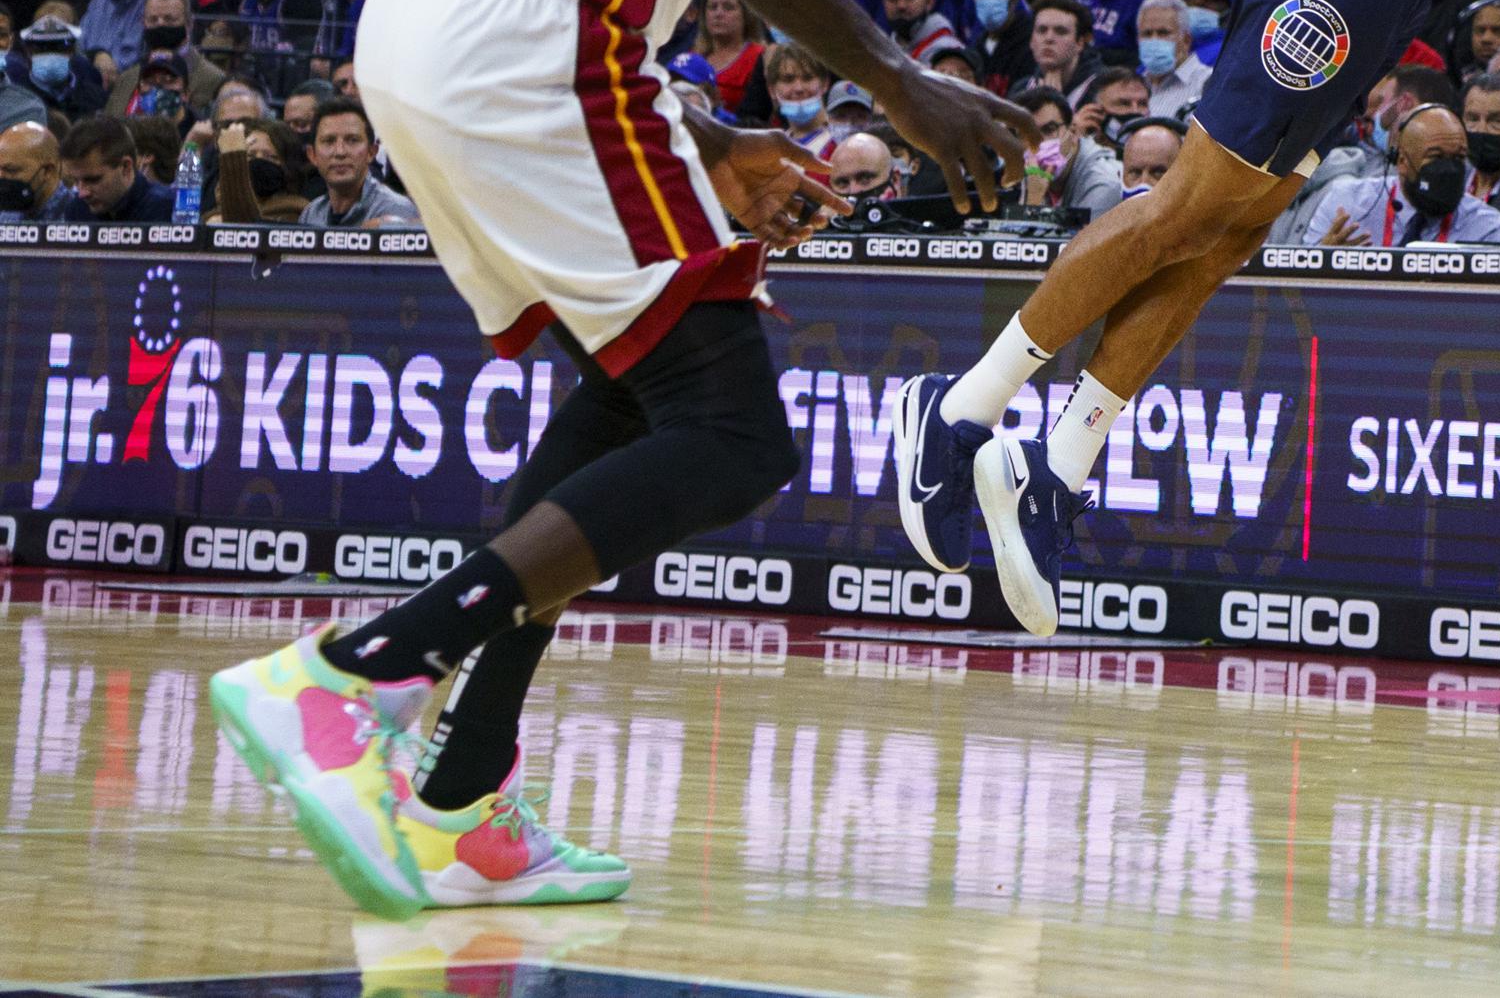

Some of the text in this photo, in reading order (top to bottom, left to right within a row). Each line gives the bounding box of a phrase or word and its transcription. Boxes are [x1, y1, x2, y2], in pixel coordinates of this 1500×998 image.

[46, 225, 89, 242] GEICO
[97, 227, 142, 244] GEICO
[149, 225, 194, 243] GEICO
[213, 229, 259, 248] GEICO
[268, 230, 315, 249] GEICO
[323, 232, 371, 251] GEICO
[379, 234, 427, 253] GEICO
[798, 239, 852, 260] GEICO
[866, 237, 920, 257] GEICO
[927, 239, 982, 260] GEICO
[992, 241, 1048, 263] GEICO
[1262, 247, 1323, 269] GEICO
[1331, 249, 1392, 272] GEICO
[1402, 250, 1465, 274] GEICO
[32, 333, 113, 510] jr.
[240, 352, 443, 478] KIDS
[46, 519, 165, 565] GEICO
[183, 526, 308, 574] GEICO
[334, 534, 463, 581] GEICO
[653, 552, 793, 605] GEICO
[827, 565, 972, 620] GEICO
[1057, 582, 1168, 633] EICO
[1220, 590, 1380, 650] GEICO
